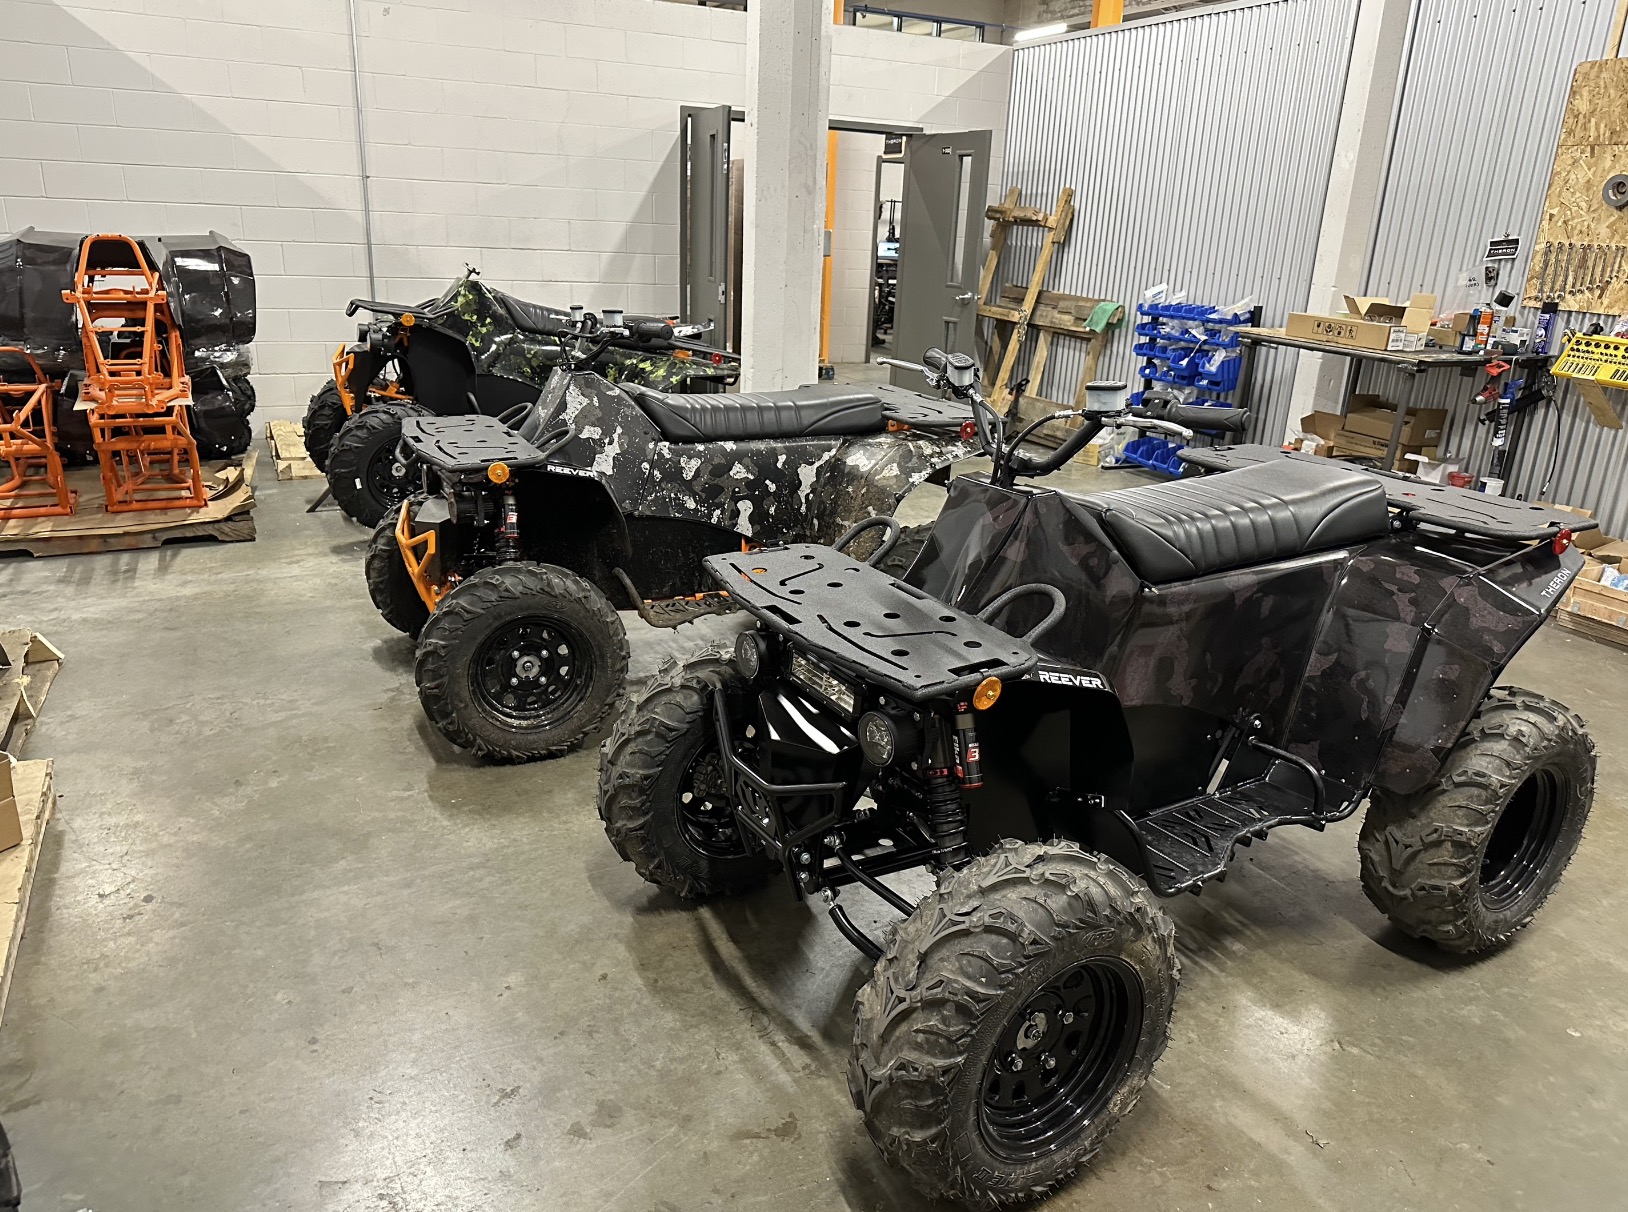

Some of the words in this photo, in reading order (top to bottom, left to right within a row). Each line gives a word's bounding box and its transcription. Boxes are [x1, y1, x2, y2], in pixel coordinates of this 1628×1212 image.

[547, 465, 597, 478] REEVER
[1540, 568, 1572, 598] THERON
[1038, 670, 1104, 689] REEVER
